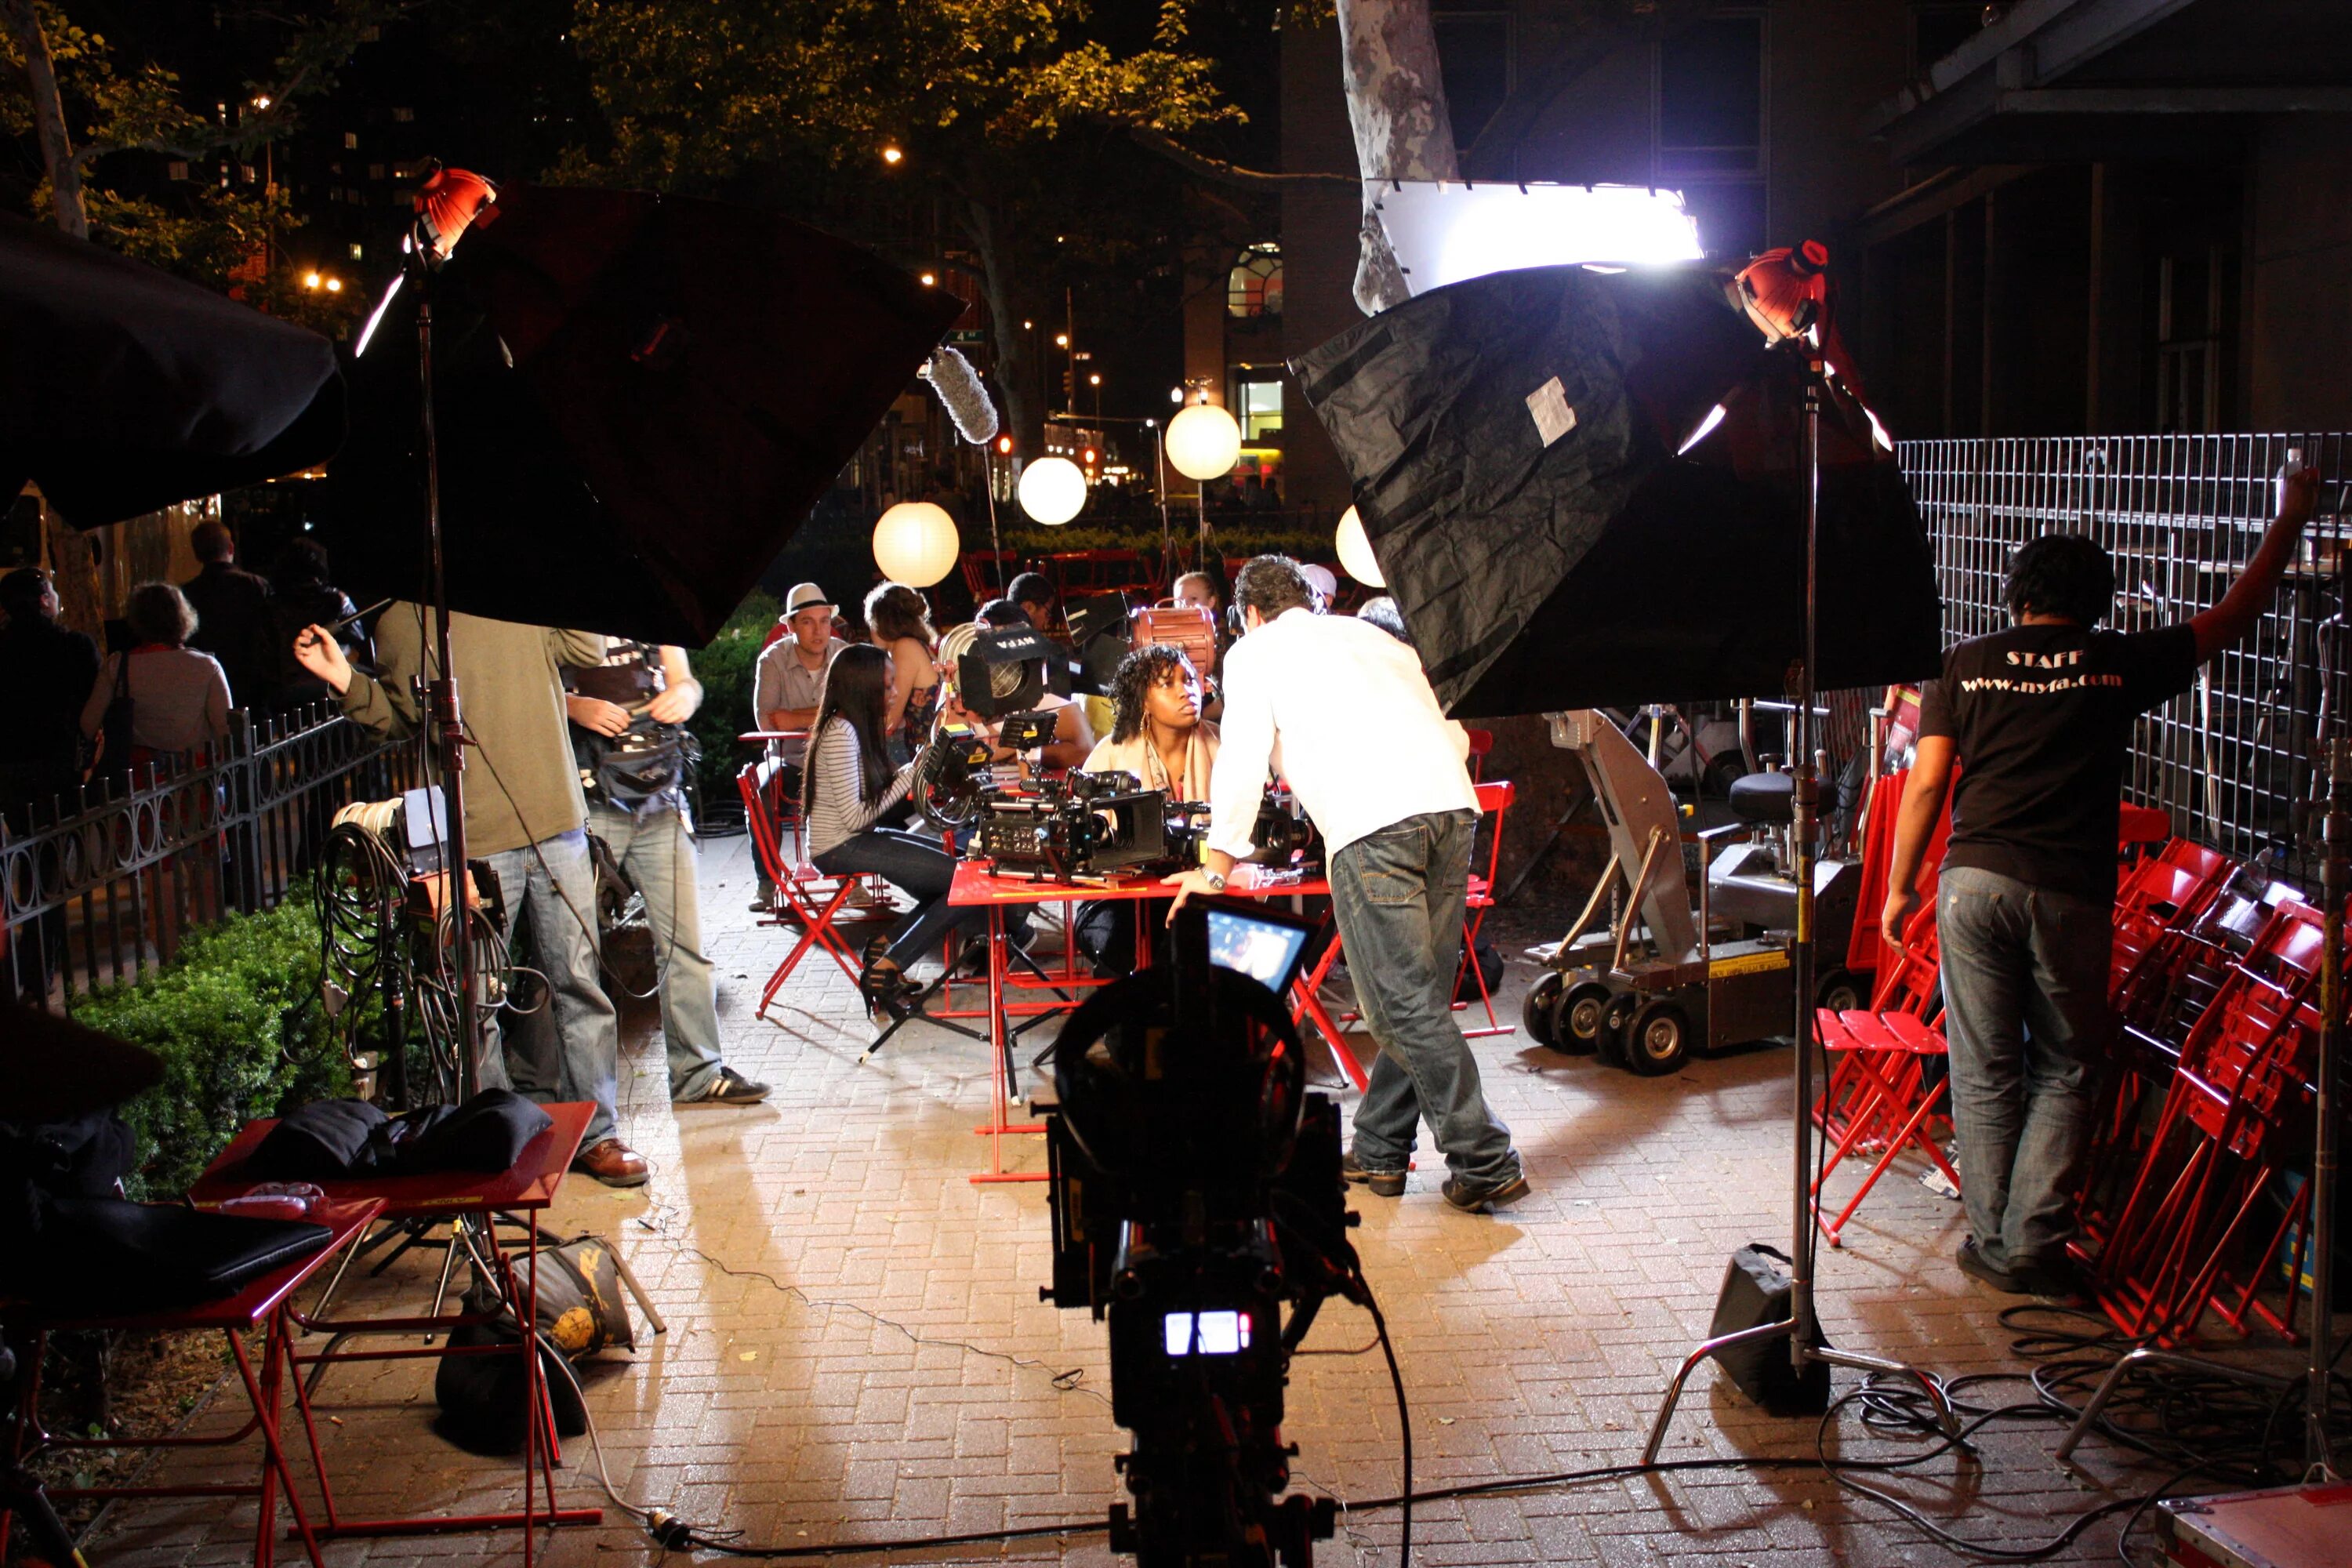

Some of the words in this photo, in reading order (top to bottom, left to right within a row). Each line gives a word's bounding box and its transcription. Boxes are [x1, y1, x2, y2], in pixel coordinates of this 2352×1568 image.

[957, 331, 964, 342] 4
[2006, 649, 2083, 670] STAFF
[1961, 674, 2122, 695] www.nyfa.com
